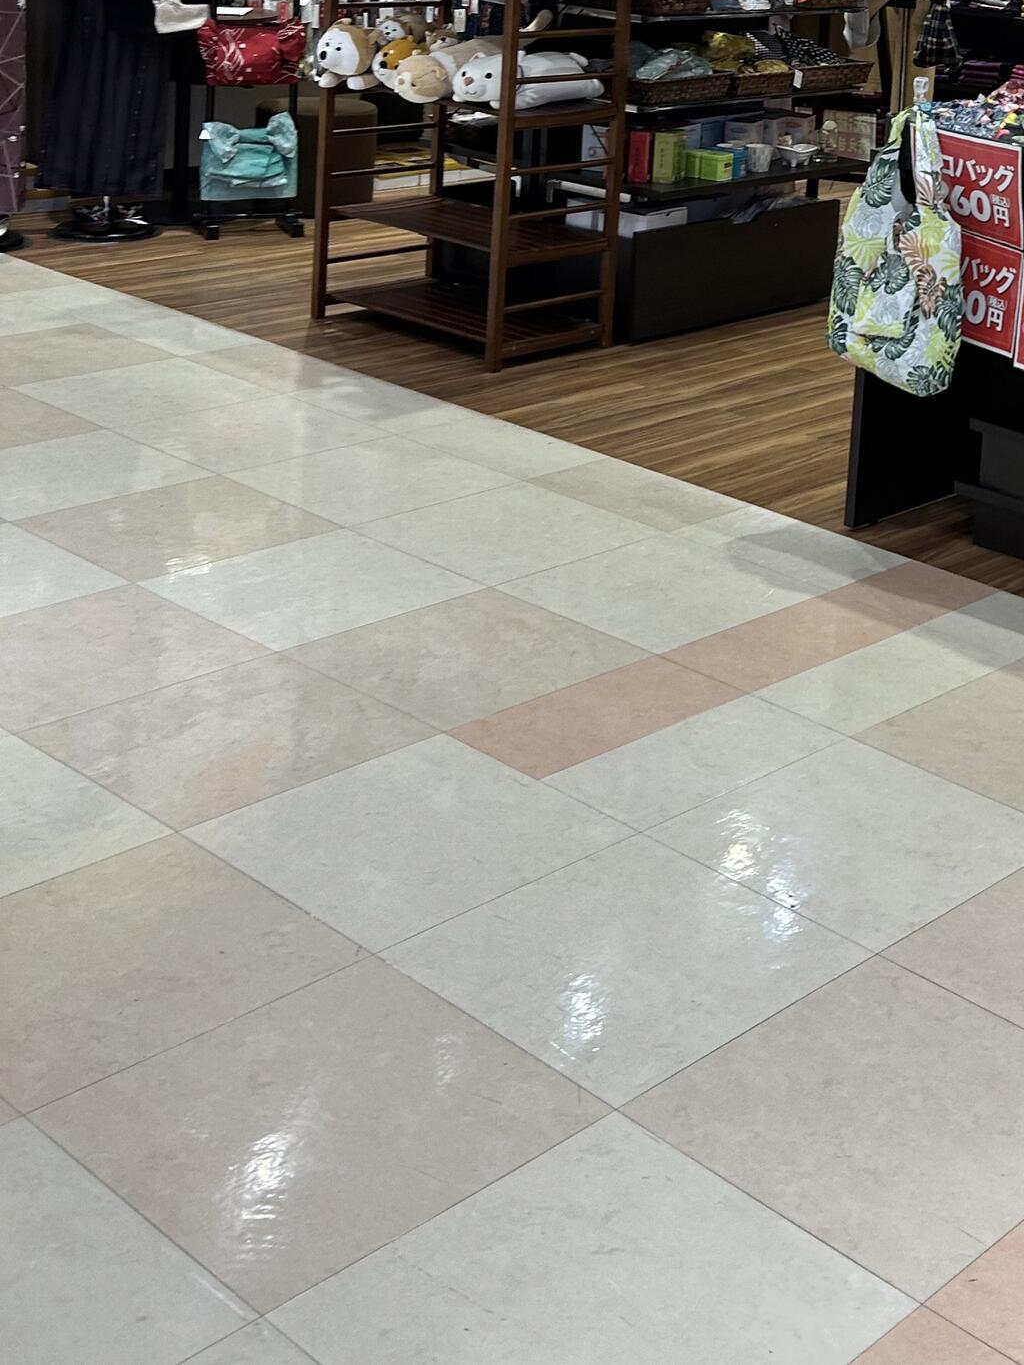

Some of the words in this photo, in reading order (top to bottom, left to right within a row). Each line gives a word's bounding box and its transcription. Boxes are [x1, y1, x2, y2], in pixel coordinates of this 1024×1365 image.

[942, 154, 1015, 192] コバッグ
[961, 255, 1017, 294] バッグ
